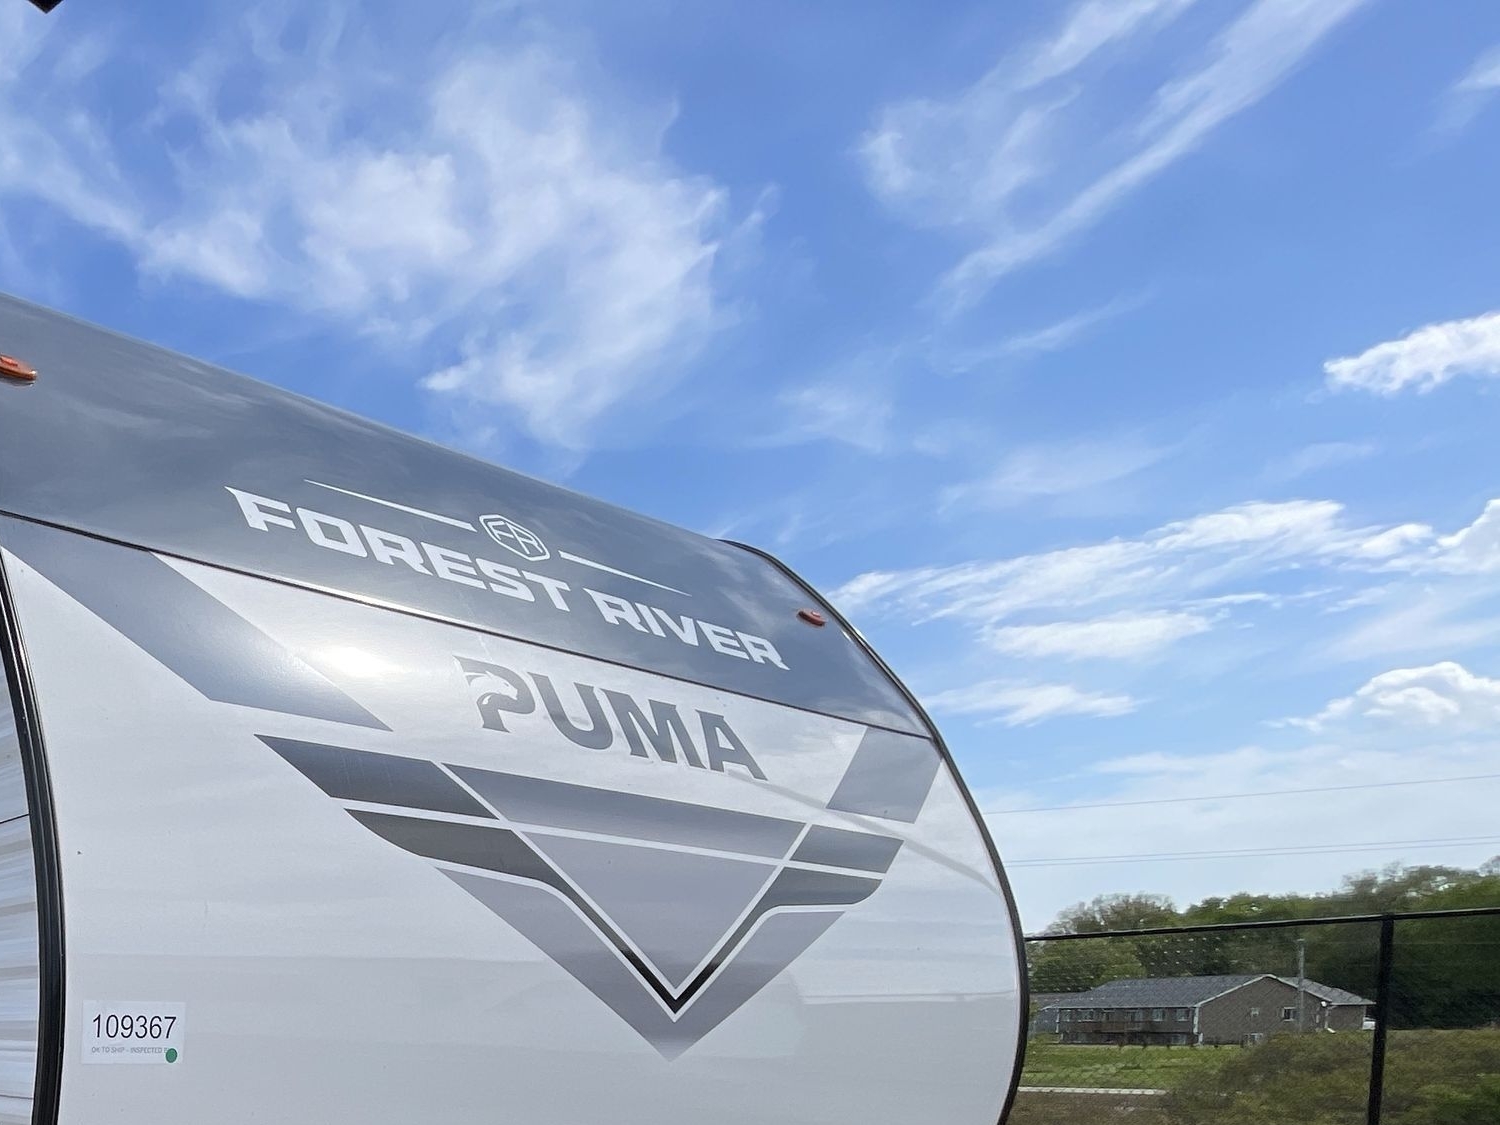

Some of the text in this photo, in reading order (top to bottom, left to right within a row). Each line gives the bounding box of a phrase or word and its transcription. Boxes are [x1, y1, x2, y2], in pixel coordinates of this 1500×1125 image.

[224, 485, 790, 671] FOREST RIVER
[453, 655, 768, 781] PUMA
[91, 1046, 101, 1054] OK
[102, 1046, 110, 1054] TO
[111, 1046, 125, 1054] SHIP
[130, 1046, 163, 1054] INSPECTED
[92, 1013, 177, 1040] 109367
